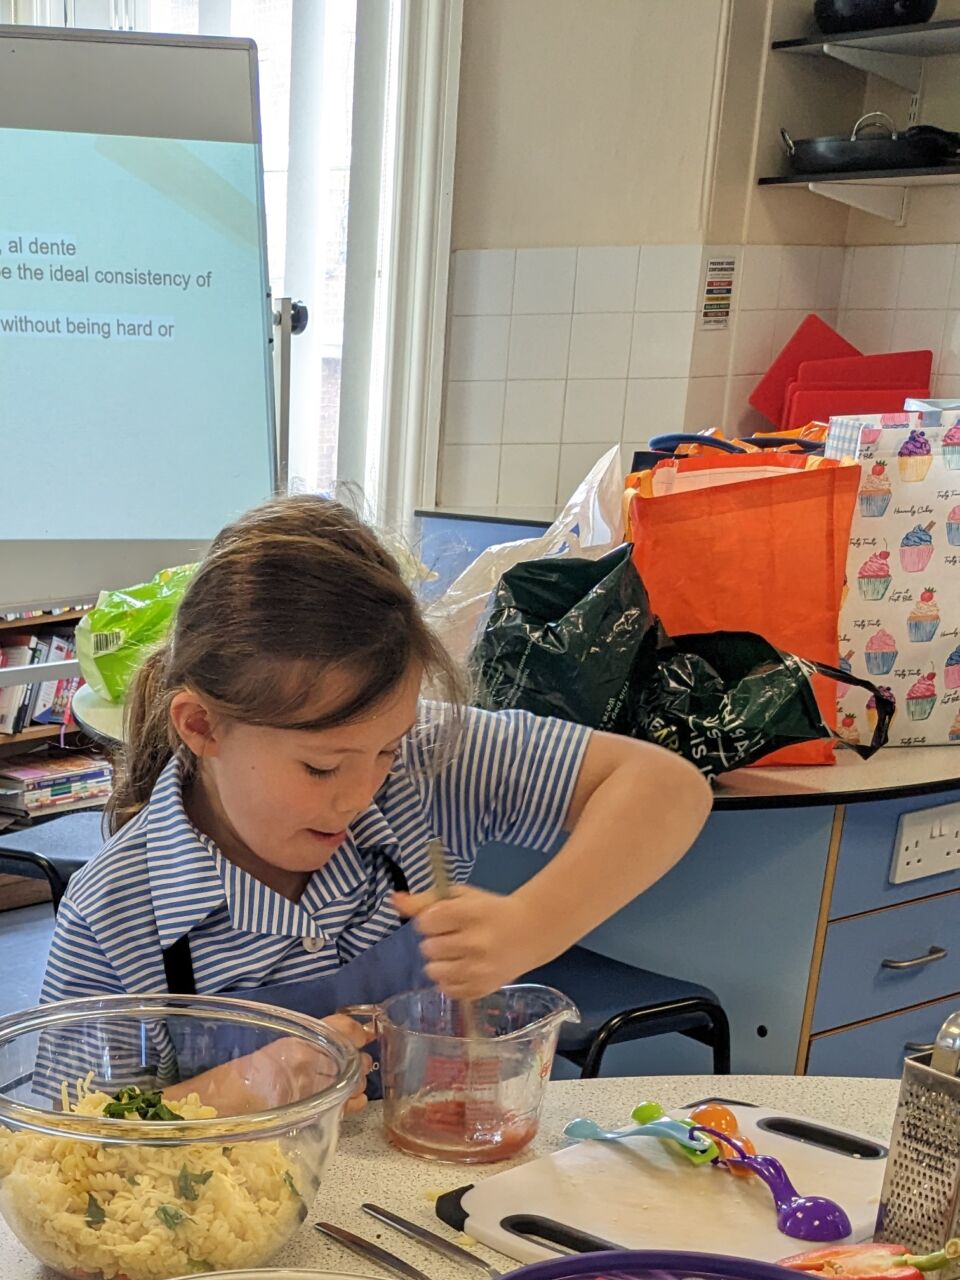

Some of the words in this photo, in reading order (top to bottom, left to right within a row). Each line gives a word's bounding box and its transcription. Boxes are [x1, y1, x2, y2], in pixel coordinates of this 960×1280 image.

[8, 237, 22, 254] al
[28, 237, 77, 256] dente
[17, 263, 44, 281] the
[49, 264, 89, 283] ideal
[94, 268, 191, 291] consistency
[196, 271, 212, 288] of
[0, 315, 61, 334] without
[66, 317, 111, 339] being
[116, 319, 153, 336] hard
[158, 324, 175, 337] or
